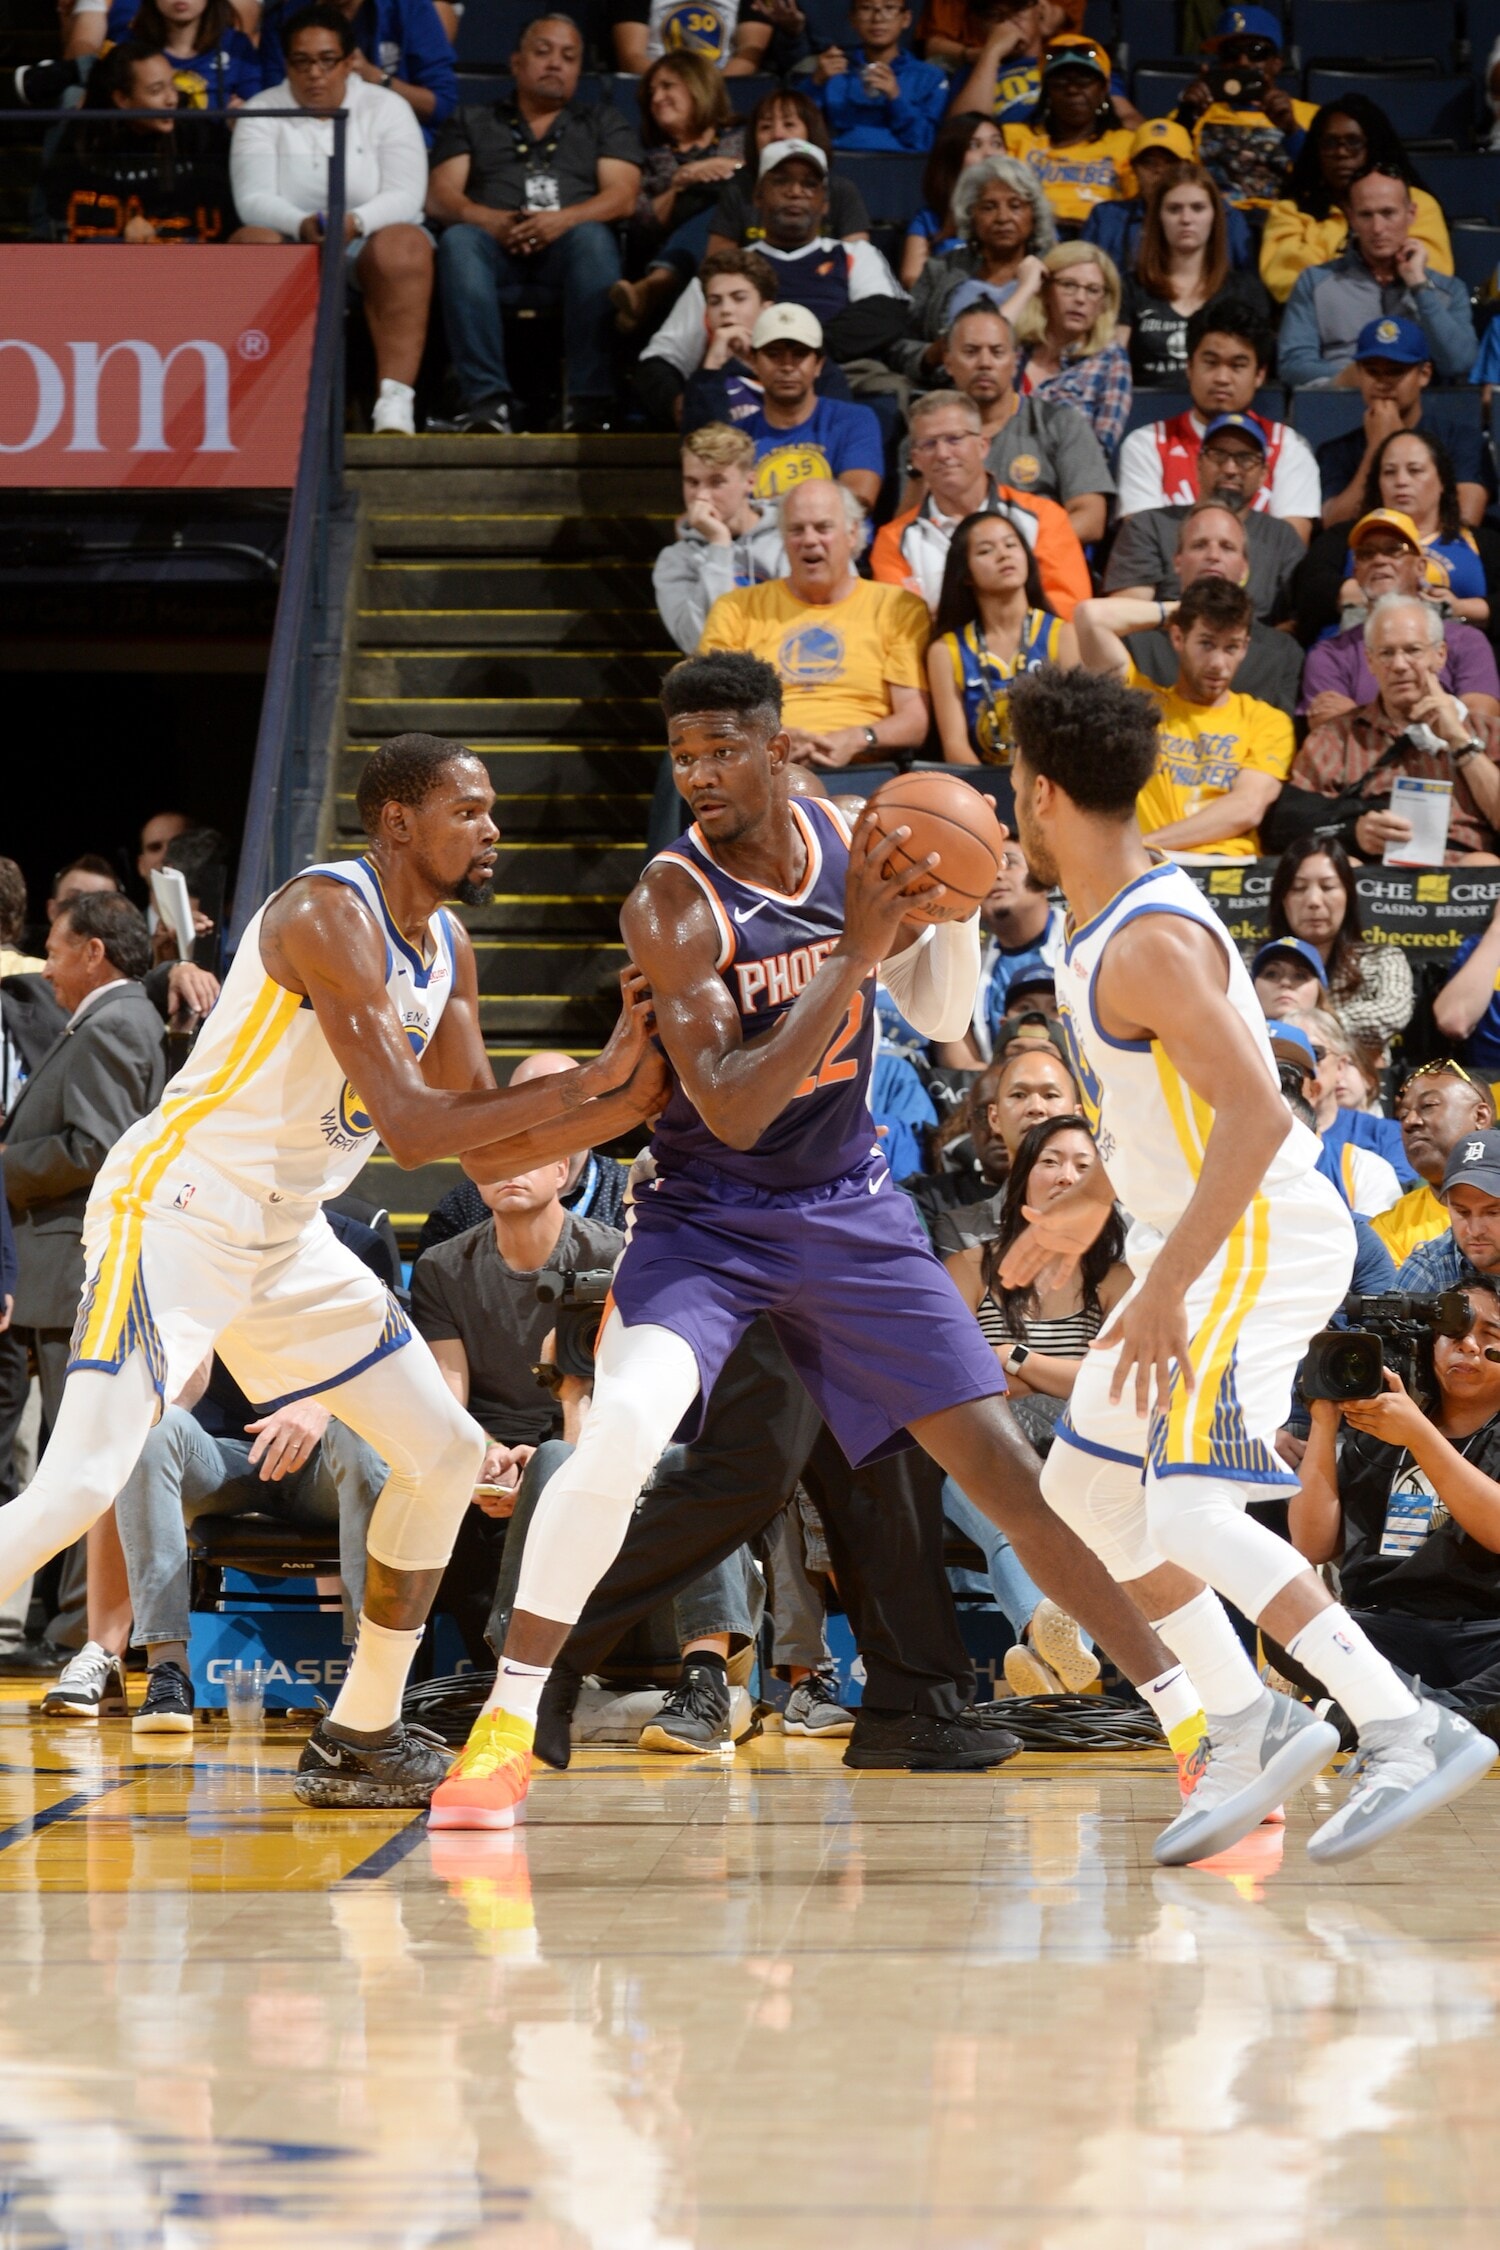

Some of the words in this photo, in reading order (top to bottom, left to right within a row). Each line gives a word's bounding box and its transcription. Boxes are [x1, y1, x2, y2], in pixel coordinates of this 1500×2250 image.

[687, 13, 717, 32] 30
[786, 459, 812, 480] 35
[1371, 902, 1427, 917] CASINO
[1435, 905, 1490, 917] RESORT
[735, 937, 841, 1015] PHOE
[1462, 1141, 1486, 1163] D
[206, 1658, 350, 1685] CHASE
